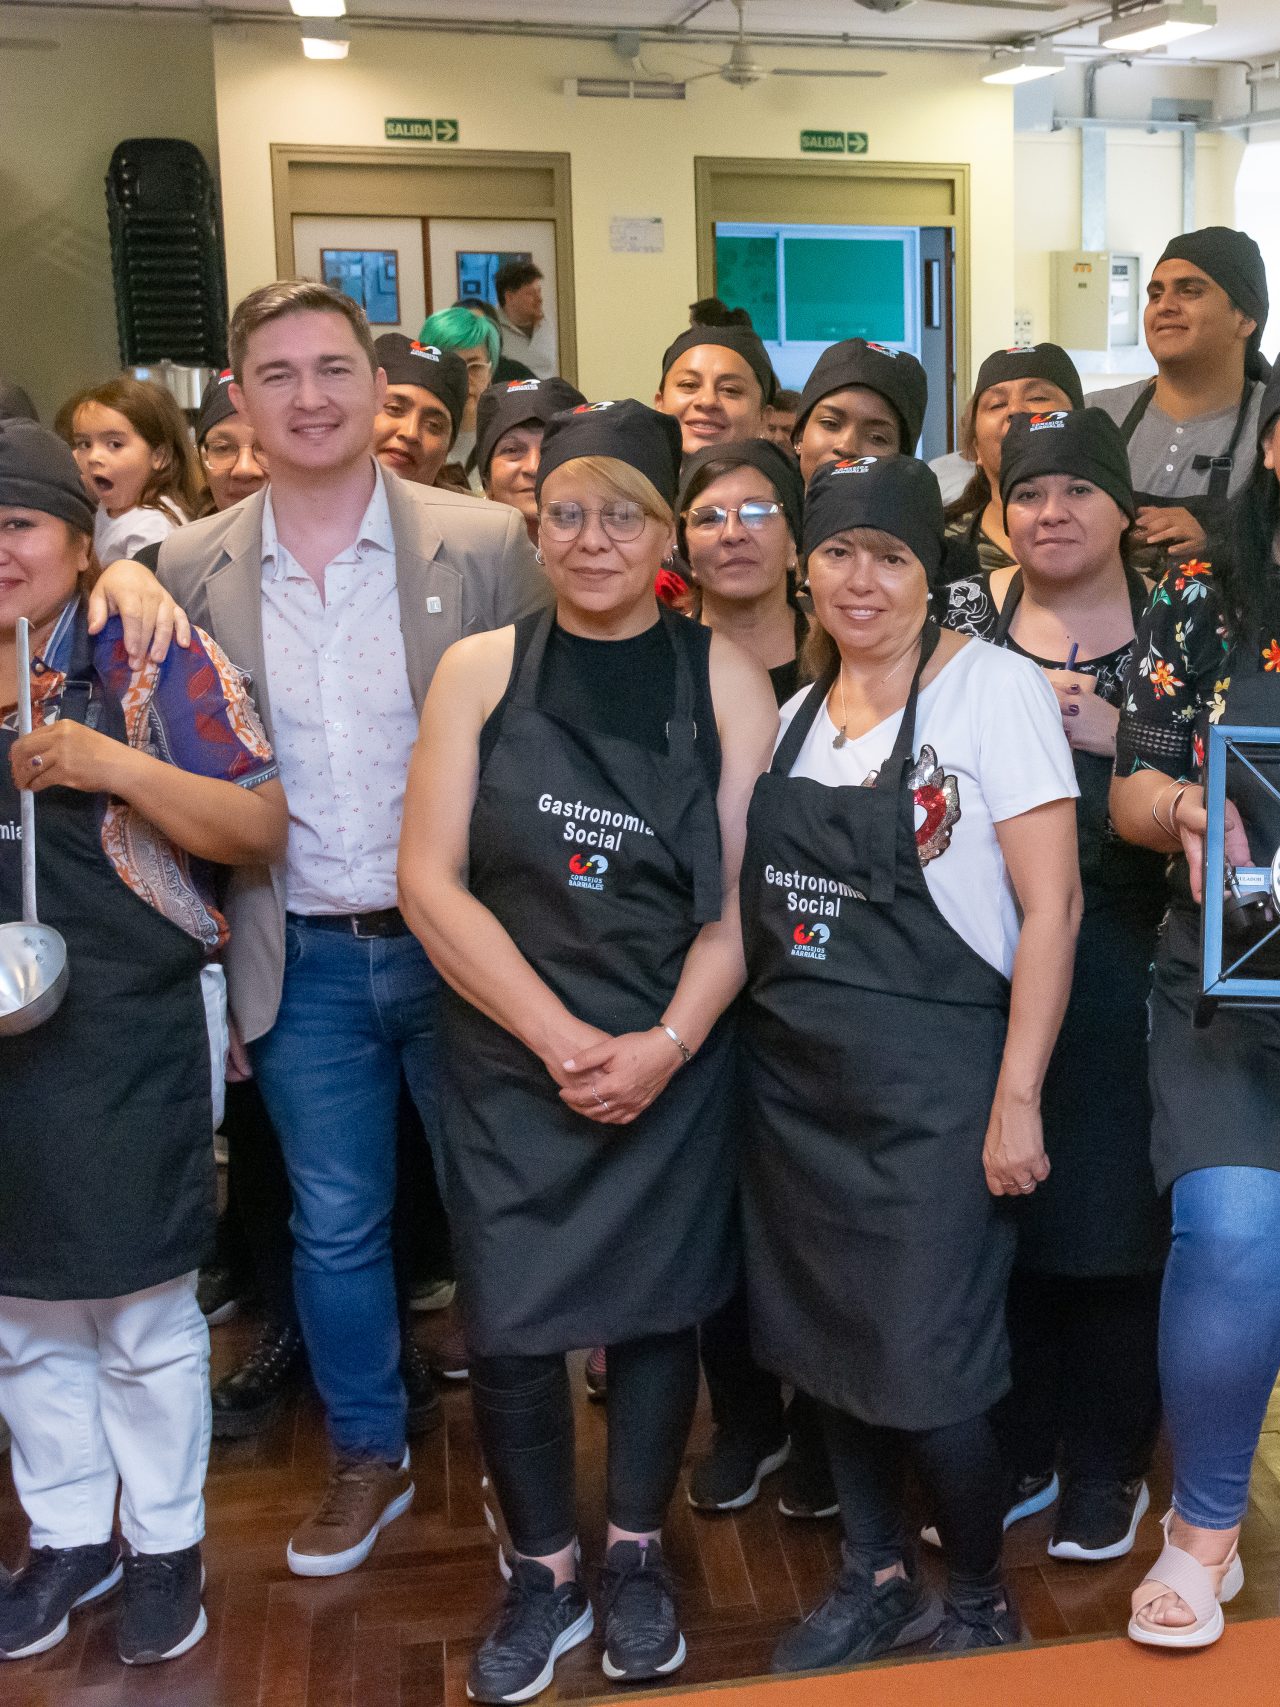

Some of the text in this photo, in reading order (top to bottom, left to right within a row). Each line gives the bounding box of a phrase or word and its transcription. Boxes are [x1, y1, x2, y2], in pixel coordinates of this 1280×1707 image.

[386, 123, 432, 137] SALIDA
[801, 136, 844, 149] SALIDA
[563, 821, 621, 852] Social
[568, 879, 604, 891] BARRIALES
[570, 874, 603, 884] CONSEJOS
[787, 891, 841, 918] Social
[790, 949, 827, 961] BARRIALES
[793, 944, 825, 954] CONSEJOS
